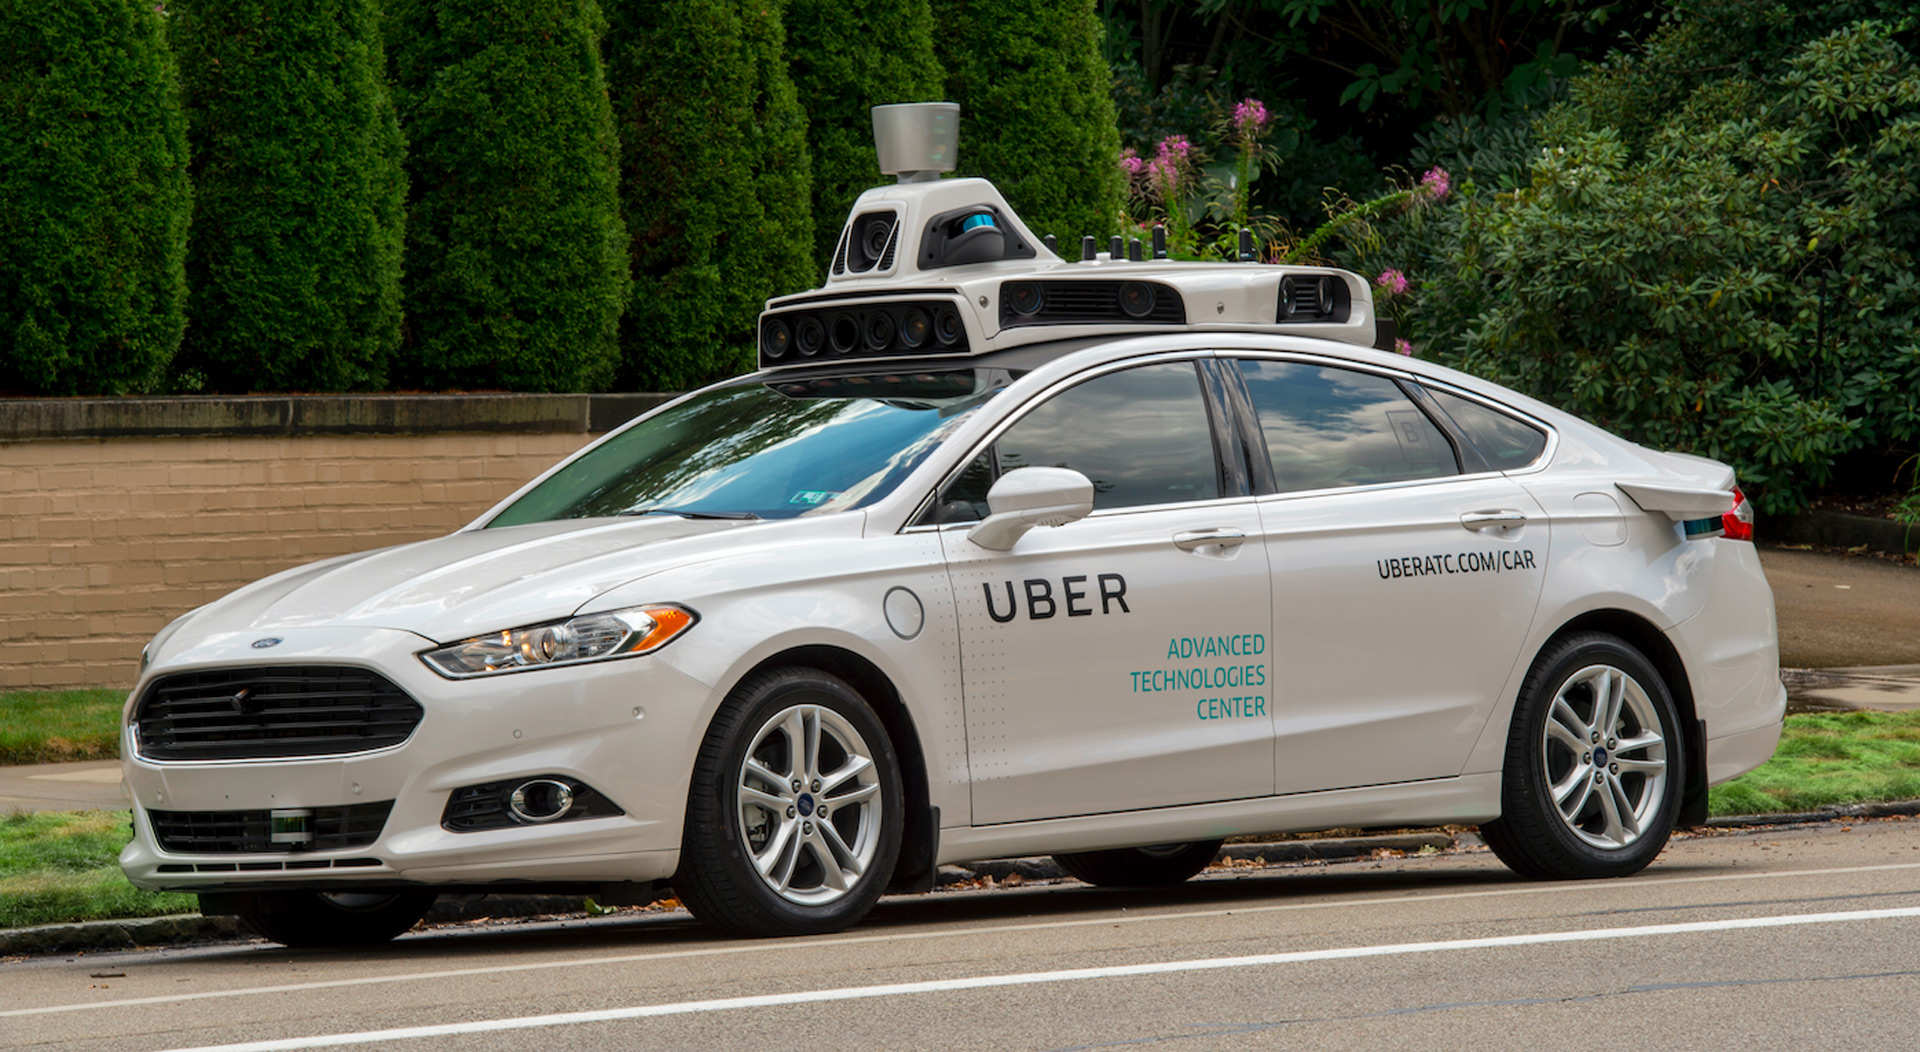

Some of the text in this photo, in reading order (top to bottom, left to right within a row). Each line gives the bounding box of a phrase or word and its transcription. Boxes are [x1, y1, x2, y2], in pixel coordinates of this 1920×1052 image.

[1377, 549, 1537, 580] UBERATC.COM/CAR
[982, 573, 1131, 624] UBER
[1167, 634, 1265, 660] ADVANCED
[1130, 665, 1266, 693] TECHNOLOGIES
[1197, 696, 1266, 720] CENTER
